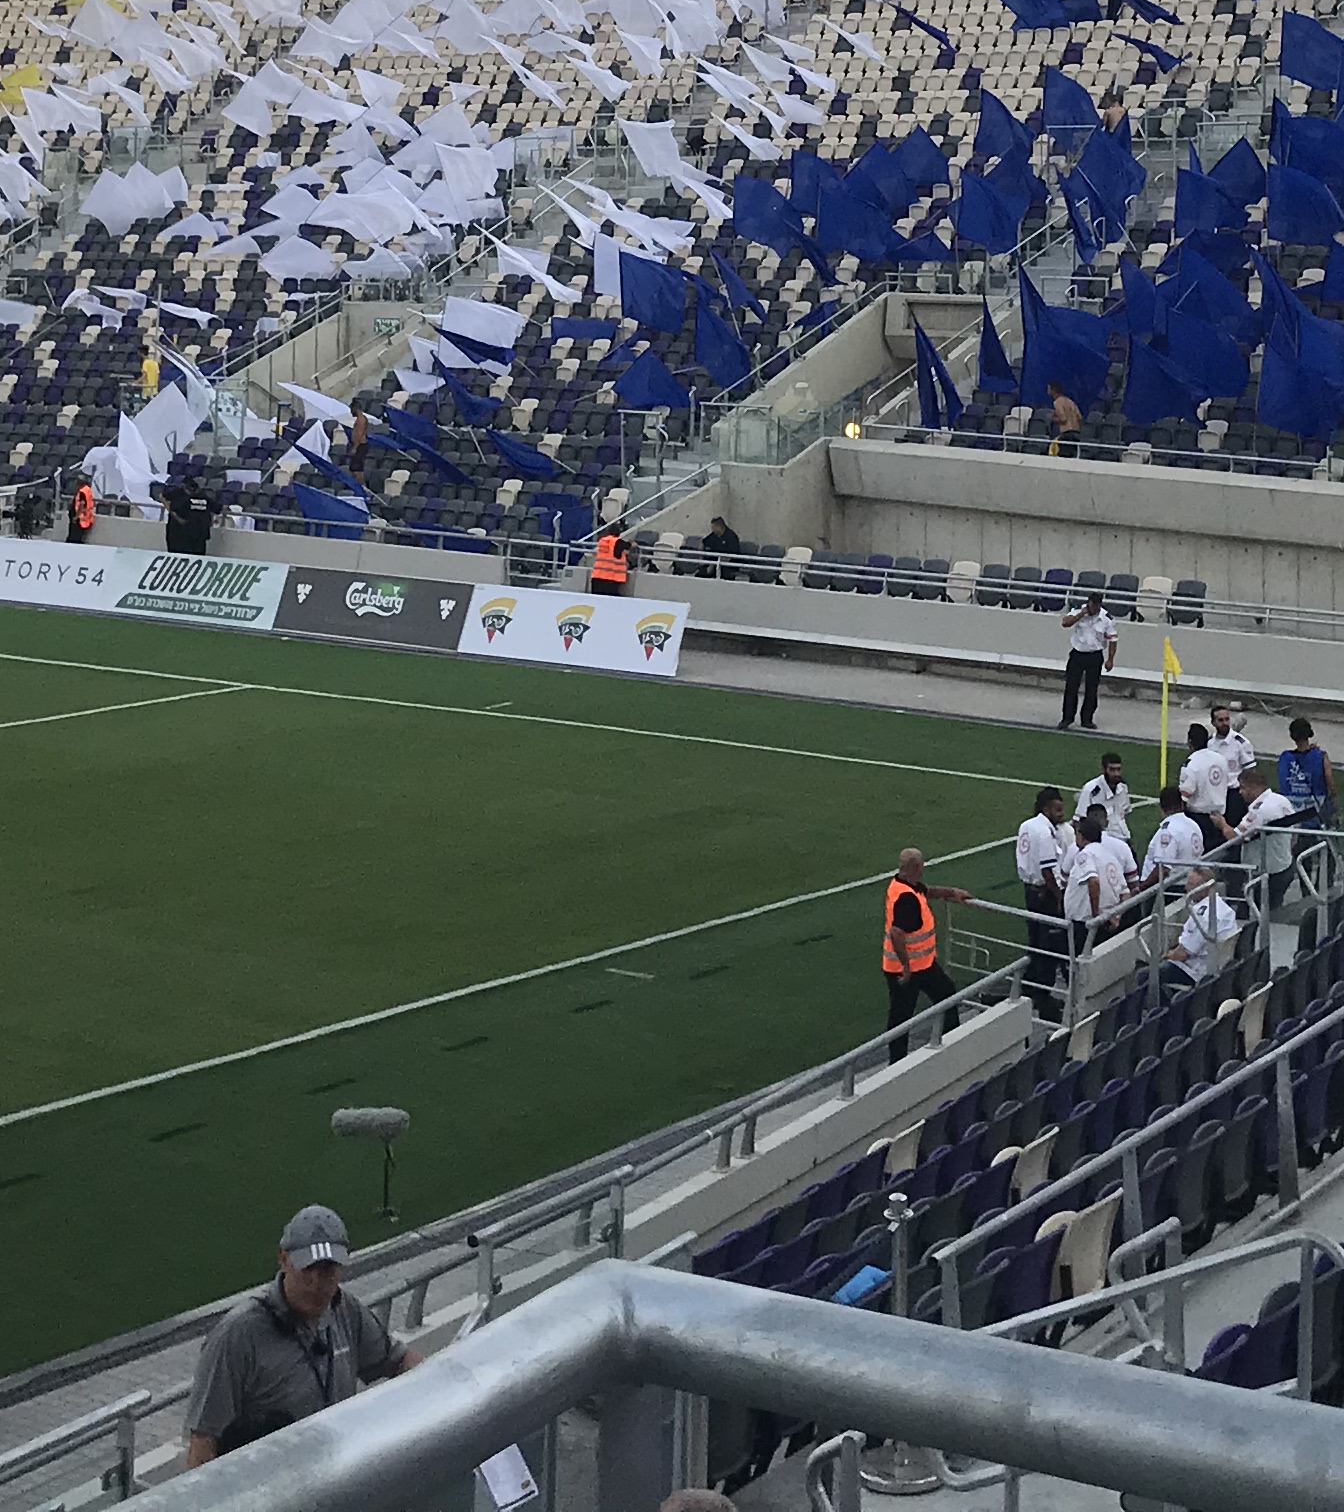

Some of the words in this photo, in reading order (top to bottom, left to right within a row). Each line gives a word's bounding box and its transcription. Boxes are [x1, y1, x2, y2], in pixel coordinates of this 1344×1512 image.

[74, 567, 105, 587] 54
[138, 555, 270, 602] EURODRIVE
[345, 581, 405, 615] Carlsberg
